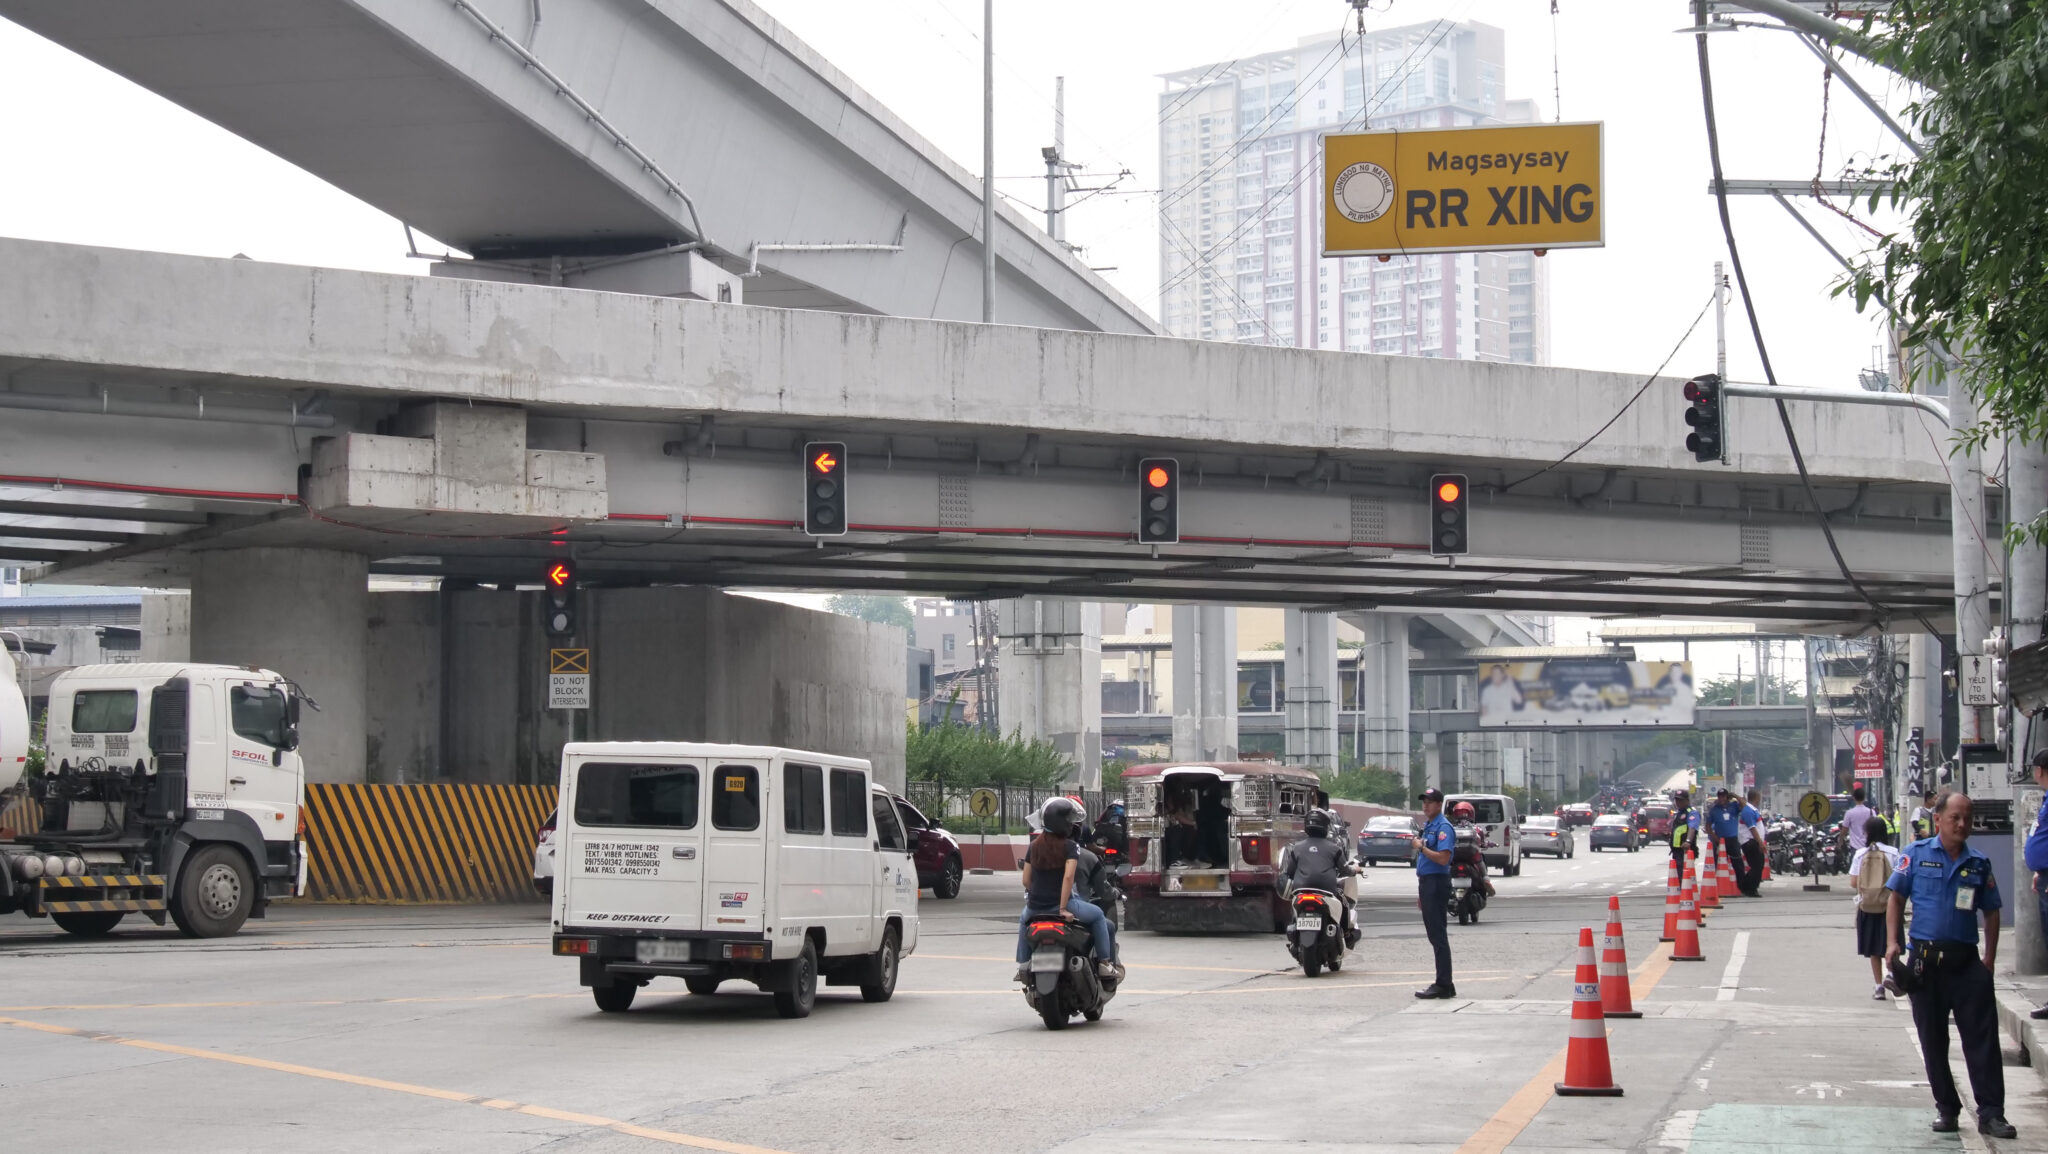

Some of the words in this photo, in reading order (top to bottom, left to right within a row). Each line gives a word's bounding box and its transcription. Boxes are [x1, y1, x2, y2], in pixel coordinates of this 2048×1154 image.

[1427, 150, 1570, 176] Magsaysay
[1335, 166, 1357, 196] LUNGSOD
[1372, 166, 1393, 194] MAYNILA
[1406, 188, 1469, 229] RR
[1486, 183, 1594, 226] XING
[1347, 210, 1380, 221] PILIPINAS
[553, 677, 565, 685] DO
[569, 677, 586, 685] NOT
[1968, 676, 1986, 684] YIELD
[555, 687, 584, 695] BLOCK
[1972, 685, 1982, 693] TO
[551, 697, 588, 706] INTERSECTION
[1969, 694, 1986, 702] PEDS
[232, 750, 269, 762] SFOIL
[646, 844, 660, 852] 1342
[619, 867, 652, 876] CAPACITY
[611, 914, 670, 923] DISTANCE!
